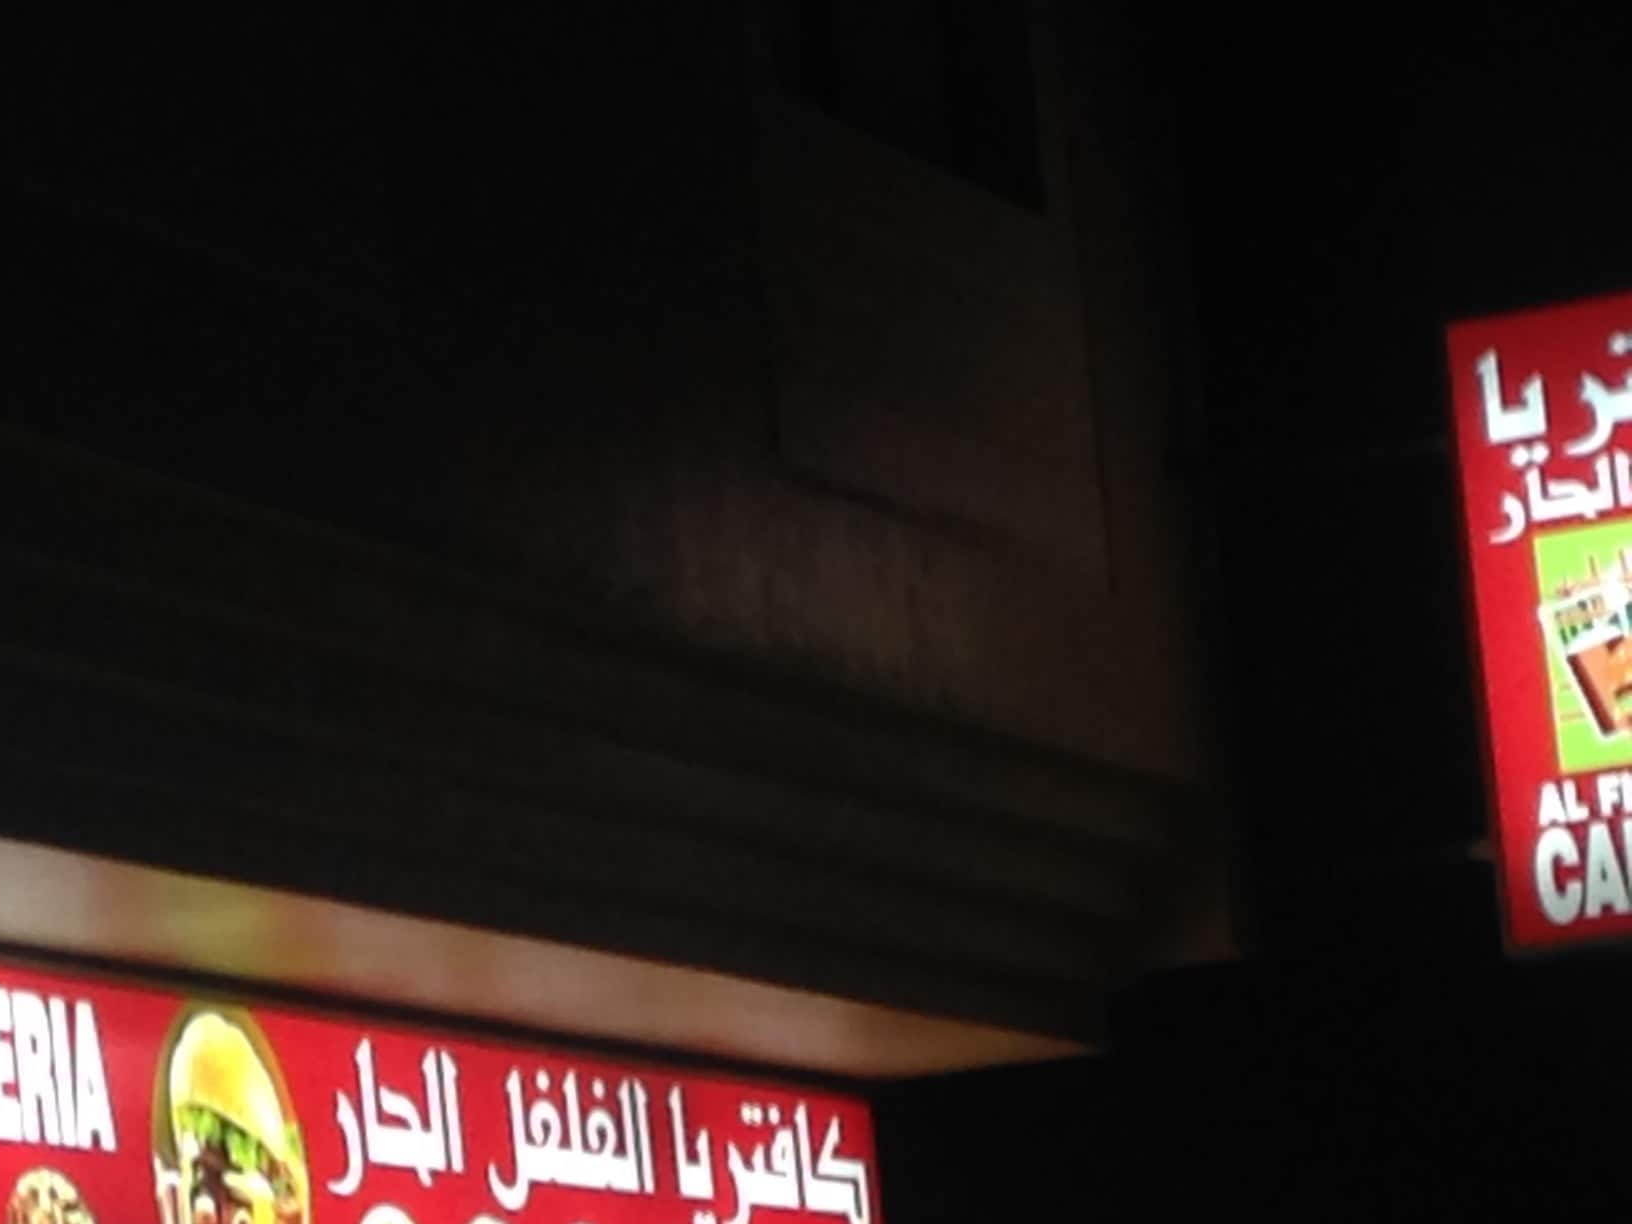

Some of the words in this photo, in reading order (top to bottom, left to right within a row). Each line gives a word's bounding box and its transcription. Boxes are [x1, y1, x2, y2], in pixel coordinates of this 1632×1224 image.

[1539, 778, 1590, 827] AL
[1535, 819, 1632, 926] CA
[327, 1034, 466, 1197] الحار
[488, 1066, 655, 1212] الفلفل
